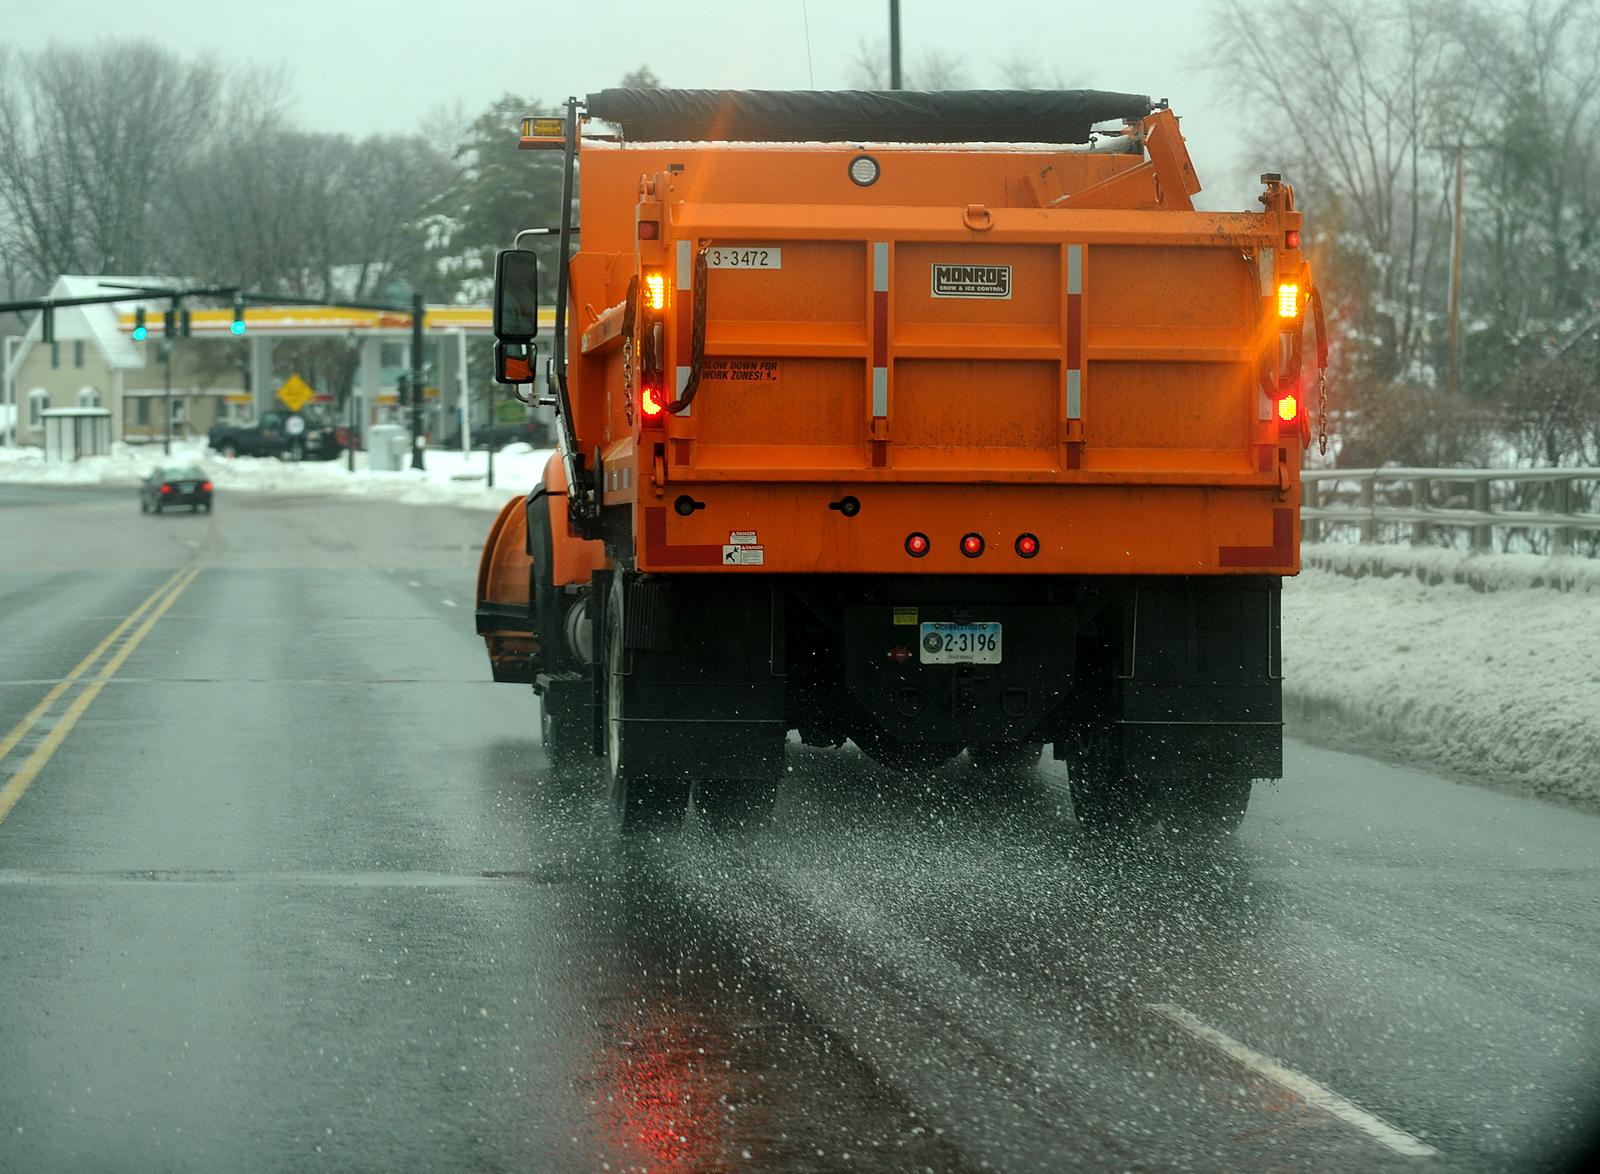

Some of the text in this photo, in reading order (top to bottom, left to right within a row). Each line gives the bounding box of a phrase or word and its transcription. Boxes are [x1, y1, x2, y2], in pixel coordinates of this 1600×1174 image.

[713, 250, 769, 266] 3-3472
[936, 267, 1008, 284] MONROE
[730, 361, 758, 370] DOWN
[759, 362, 778, 370] FOR
[702, 370, 764, 380] WORK ZONES!
